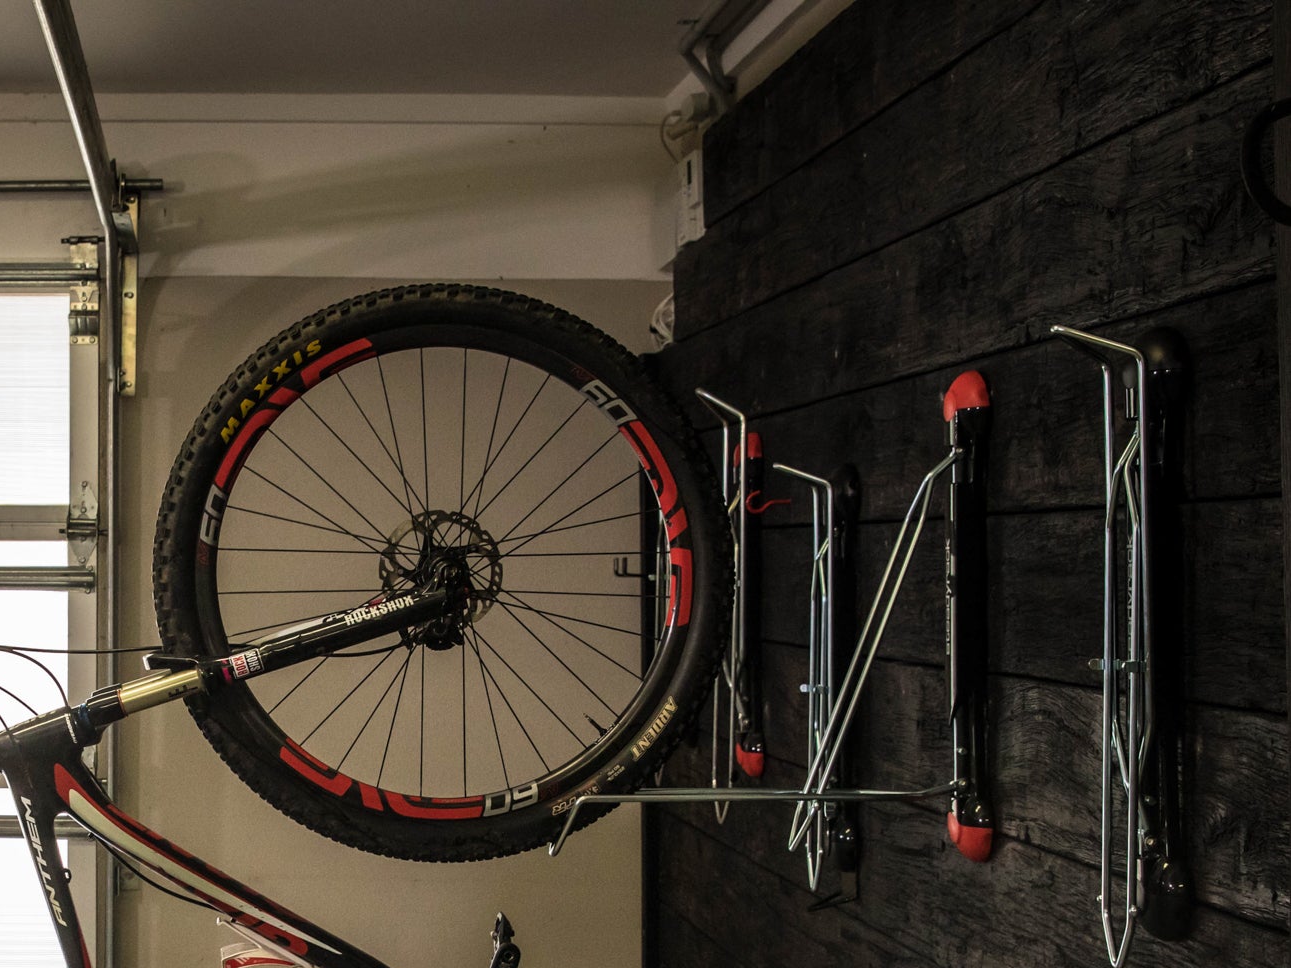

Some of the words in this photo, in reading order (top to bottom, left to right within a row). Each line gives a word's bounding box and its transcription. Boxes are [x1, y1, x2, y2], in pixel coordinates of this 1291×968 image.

[220, 339, 322, 444] MAXXIS
[631, 695, 678, 762] ARDENT
[21, 796, 68, 927] ANTHEM
